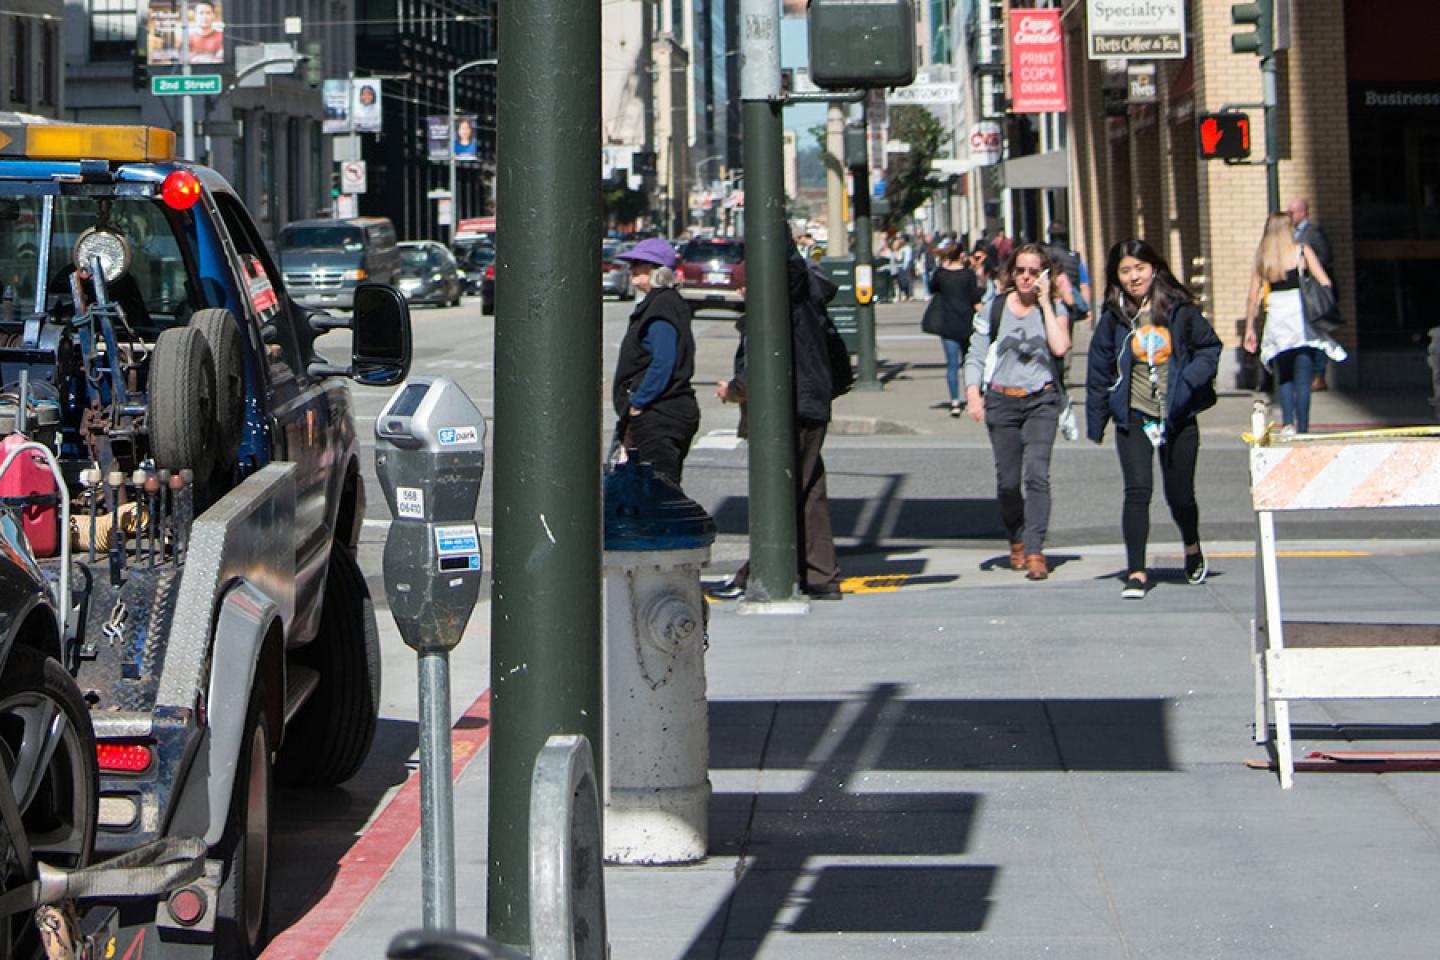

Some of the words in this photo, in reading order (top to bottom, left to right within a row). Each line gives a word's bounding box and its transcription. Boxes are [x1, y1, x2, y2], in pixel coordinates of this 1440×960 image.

[1095, 1, 1177, 22] Specialty's
[1121, 36, 1151, 53] Coffee
[1160, 34, 1179, 51] Tea
[1020, 52, 1055, 65] PRINT
[1021, 66, 1057, 80] COPY
[159, 80, 180, 90] 2nd
[183, 79, 216, 89] Street
[1021, 82, 1057, 94] DESIGN
[970, 132, 1000, 148] CVS
